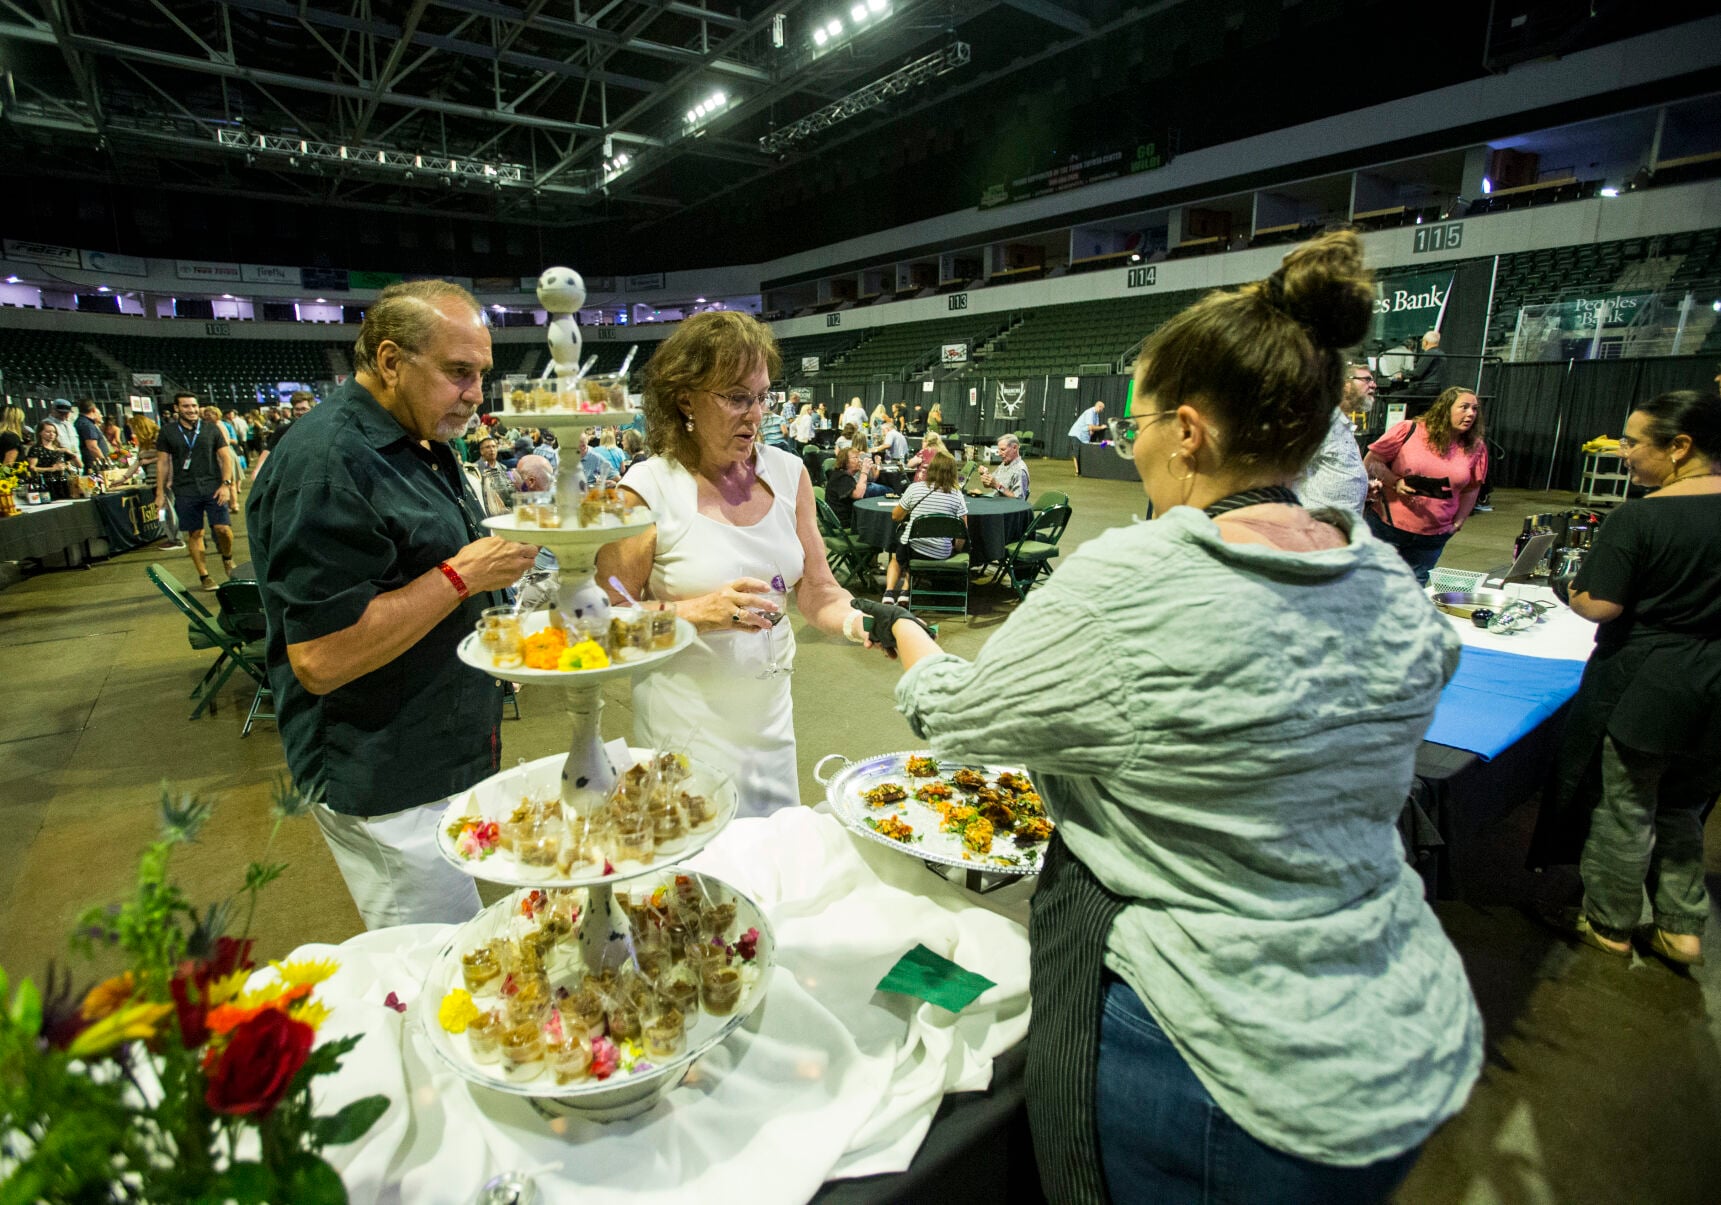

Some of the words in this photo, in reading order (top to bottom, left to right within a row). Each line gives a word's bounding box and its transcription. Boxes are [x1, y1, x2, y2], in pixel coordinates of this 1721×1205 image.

[1417, 225, 1461, 251] 115
[1129, 267, 1155, 287] 114
[949, 294, 967, 311] 113
[1391, 284, 1444, 313] Bank
[827, 313, 840, 327] 112
